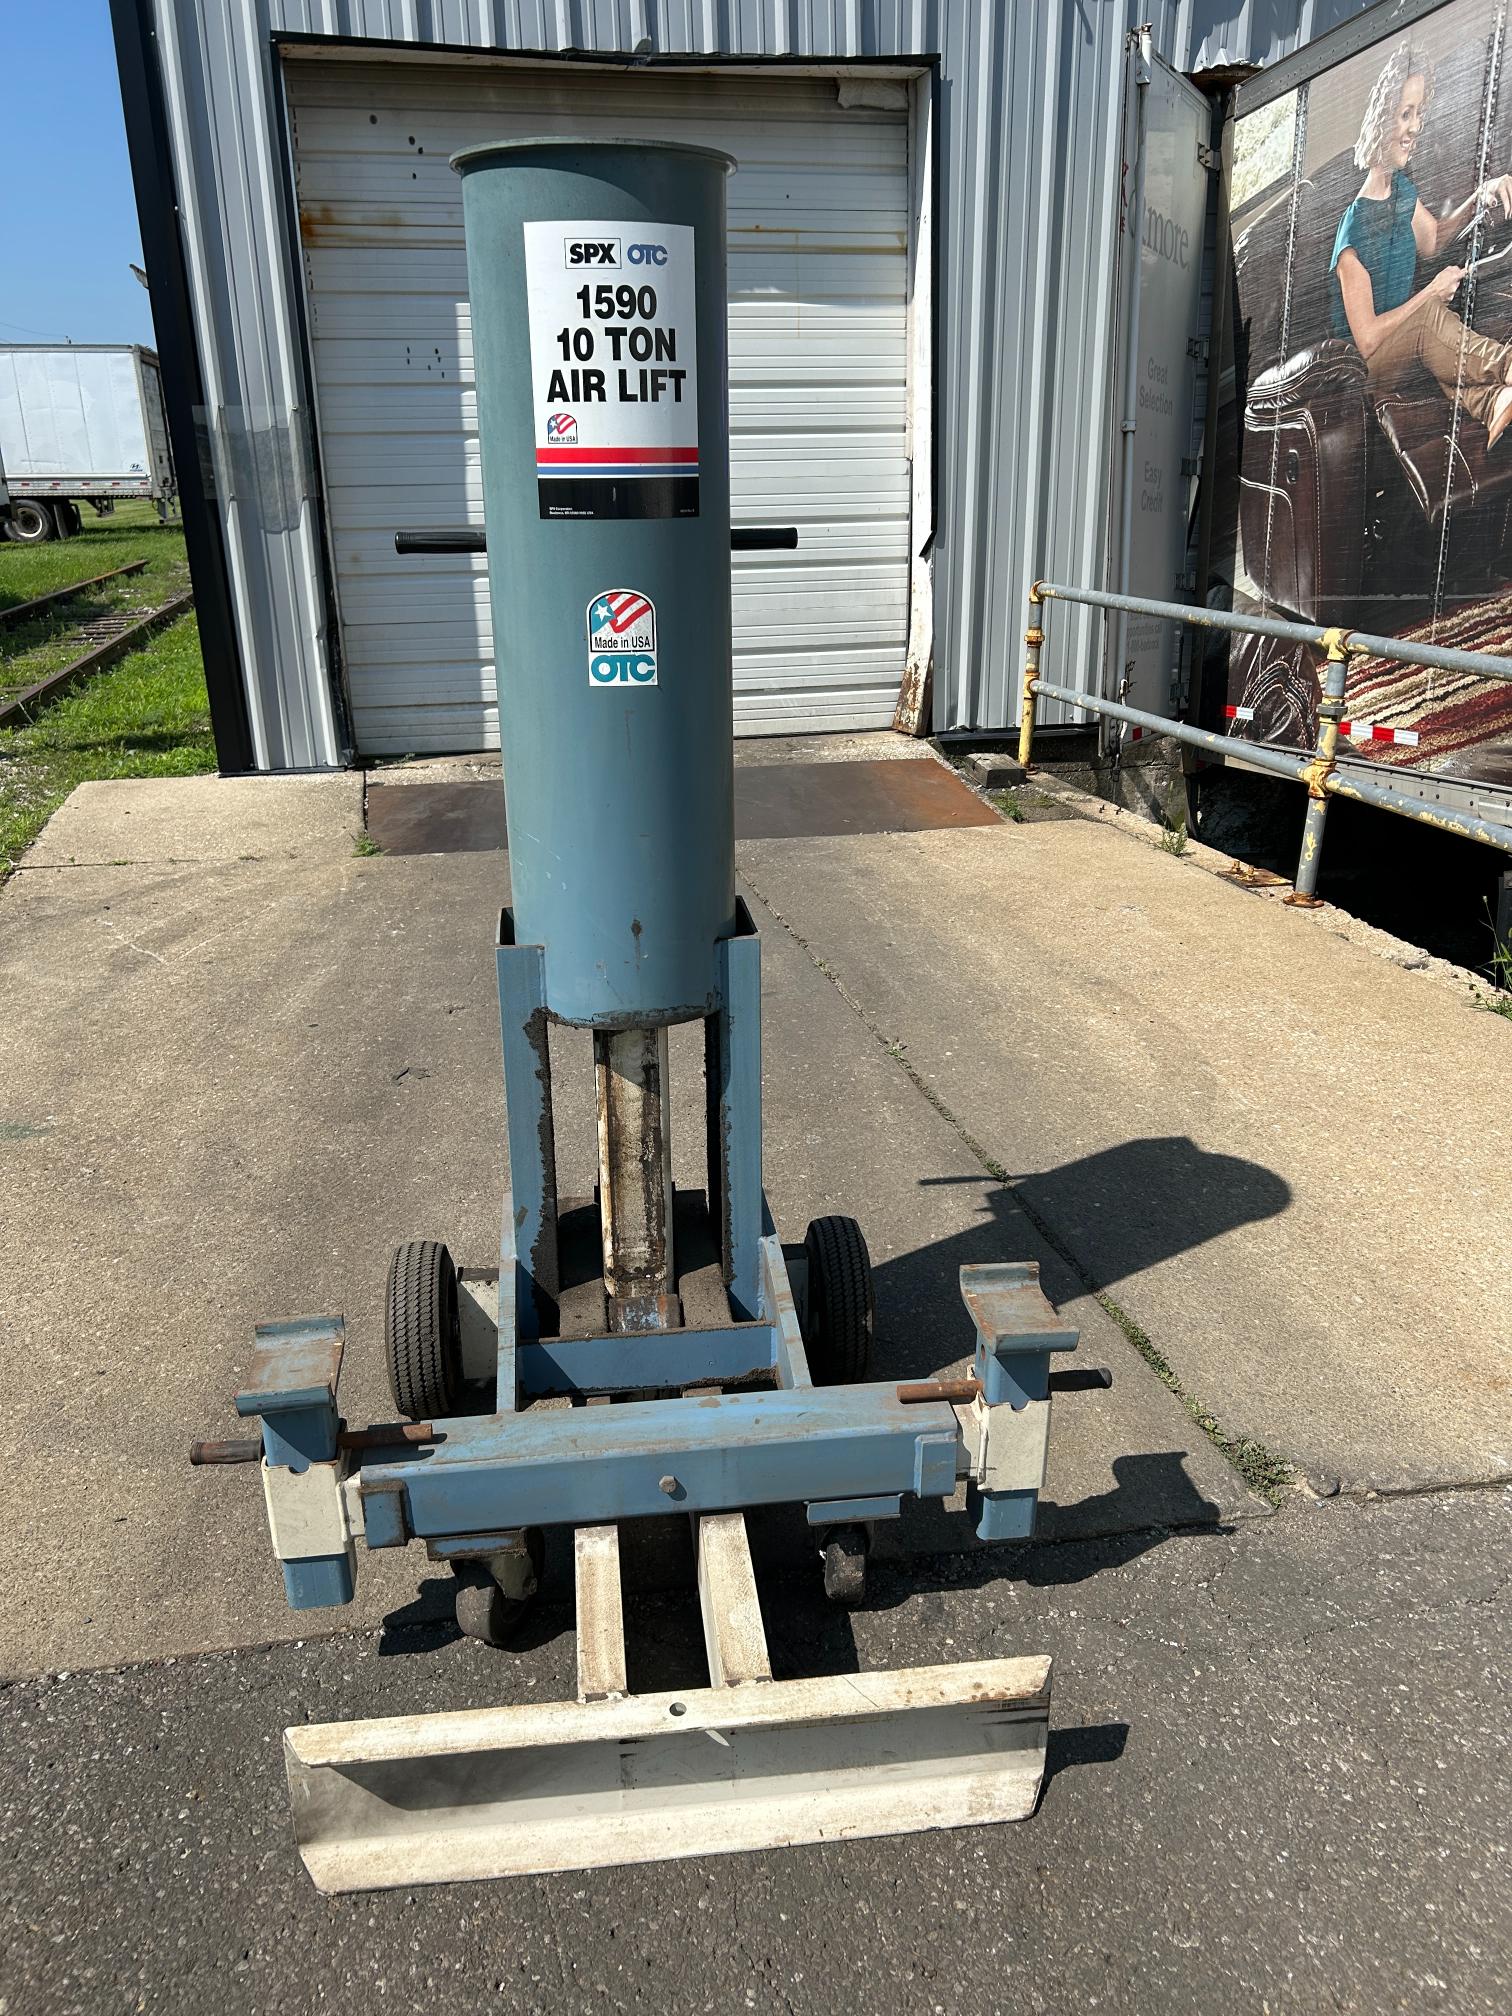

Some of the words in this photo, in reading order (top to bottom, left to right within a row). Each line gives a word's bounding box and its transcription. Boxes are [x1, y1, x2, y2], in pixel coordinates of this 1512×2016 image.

[569, 242, 617, 264] SPX
[627, 243, 668, 266] OTC
[576, 284, 657, 320] 1590
[556, 327, 595, 362] 10
[604, 326, 677, 362] TON
[546, 368, 607, 403] AIR
[618, 368, 687, 403] LIFT
[594, 636, 619, 649] Made
[620, 636, 629, 648] in
[631, 635, 651, 648] USA
[590, 654, 656, 683] OTC
